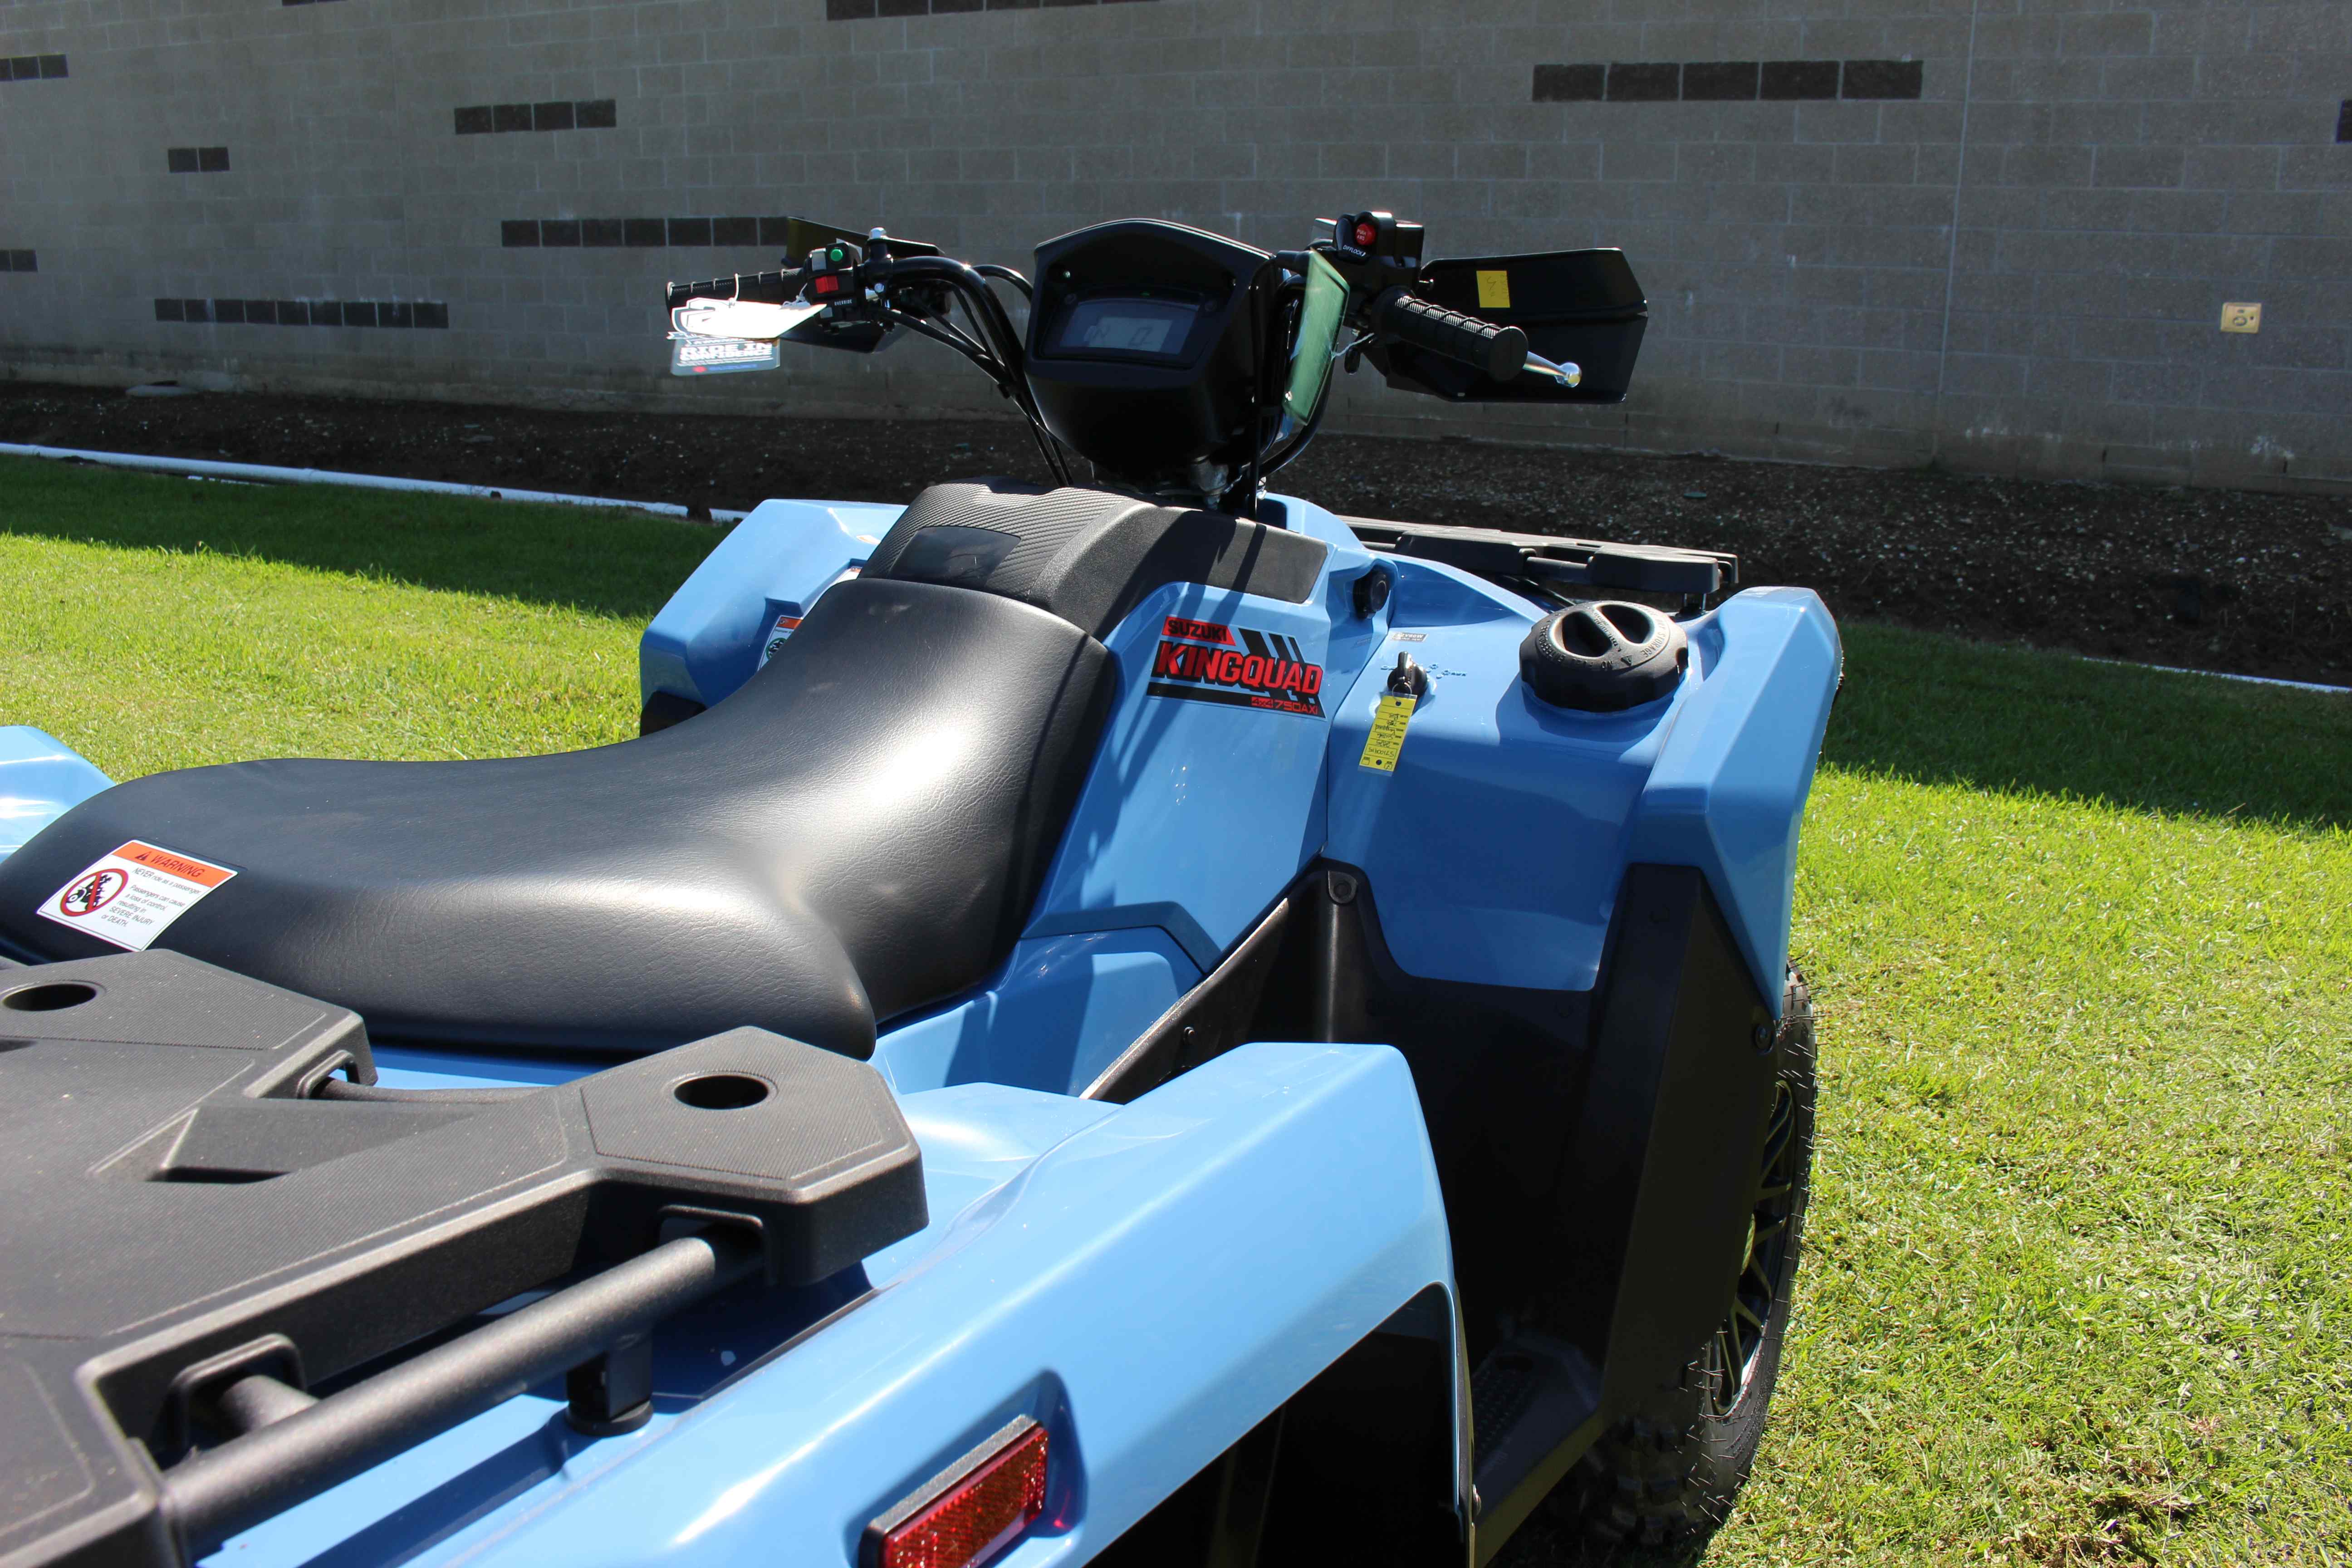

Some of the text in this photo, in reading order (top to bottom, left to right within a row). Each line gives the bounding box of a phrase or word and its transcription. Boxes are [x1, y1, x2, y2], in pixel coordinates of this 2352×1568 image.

[680, 350, 773, 361] CONFIDENCE
[681, 344, 739, 356] RIDE
[1168, 620, 1227, 642] SUZUKI
[1155, 642, 1324, 695] KINGQUAD
[1251, 697, 1273, 708] 4x4
[151, 855, 206, 877] WARNING
[133, 867, 155, 879] NEVER
[152, 873, 162, 882] ride
[130, 884, 160, 899] Passengers
[117, 900, 142, 913] resulting
[109, 906, 154, 926] SEVERE INJURY
